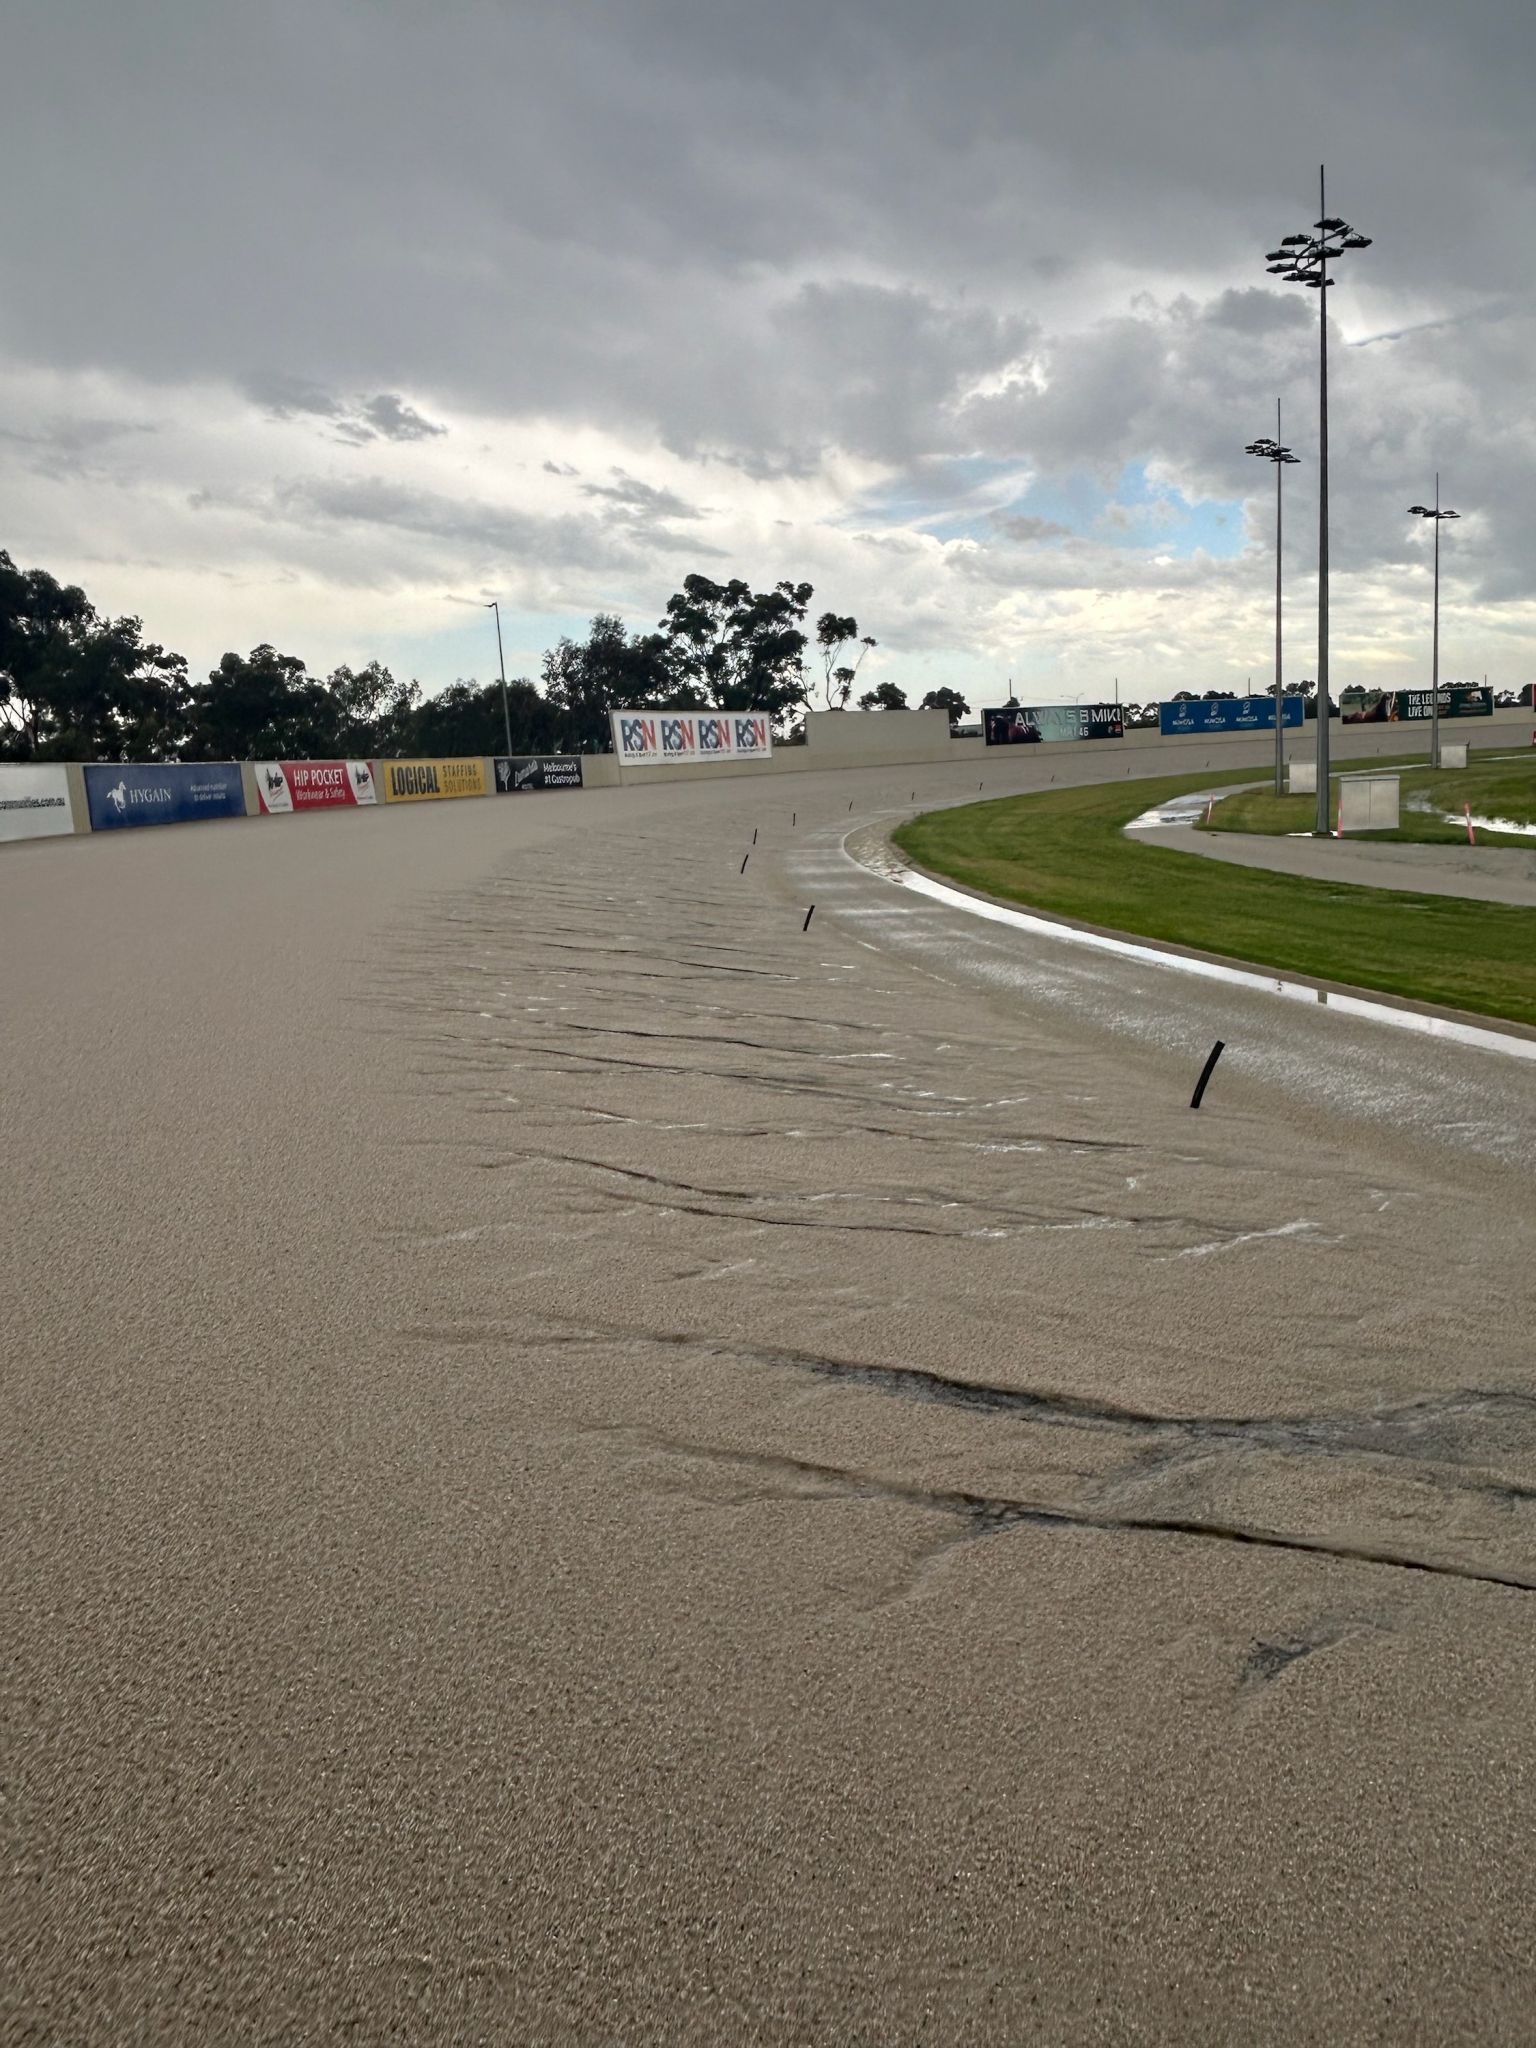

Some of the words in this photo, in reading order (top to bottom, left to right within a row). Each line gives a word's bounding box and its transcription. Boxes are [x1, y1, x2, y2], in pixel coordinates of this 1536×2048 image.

[1408, 694, 1421, 705] THE
[1080, 709, 1089, 723] B
[1408, 705, 1422, 717] LIVE
[621, 719, 656, 751] RSN
[661, 719, 695, 751] RSN
[698, 719, 731, 749] RSN
[735, 718, 766, 748] RSN
[294, 769, 309, 787] HIP
[311, 768, 344, 786] POCKET
[443, 764, 477, 778] STAFFING
[391, 766, 440, 796] LOGICAL
[444, 778, 481, 793] SOLUTIONS
[130, 788, 171, 803] HYGAIN
